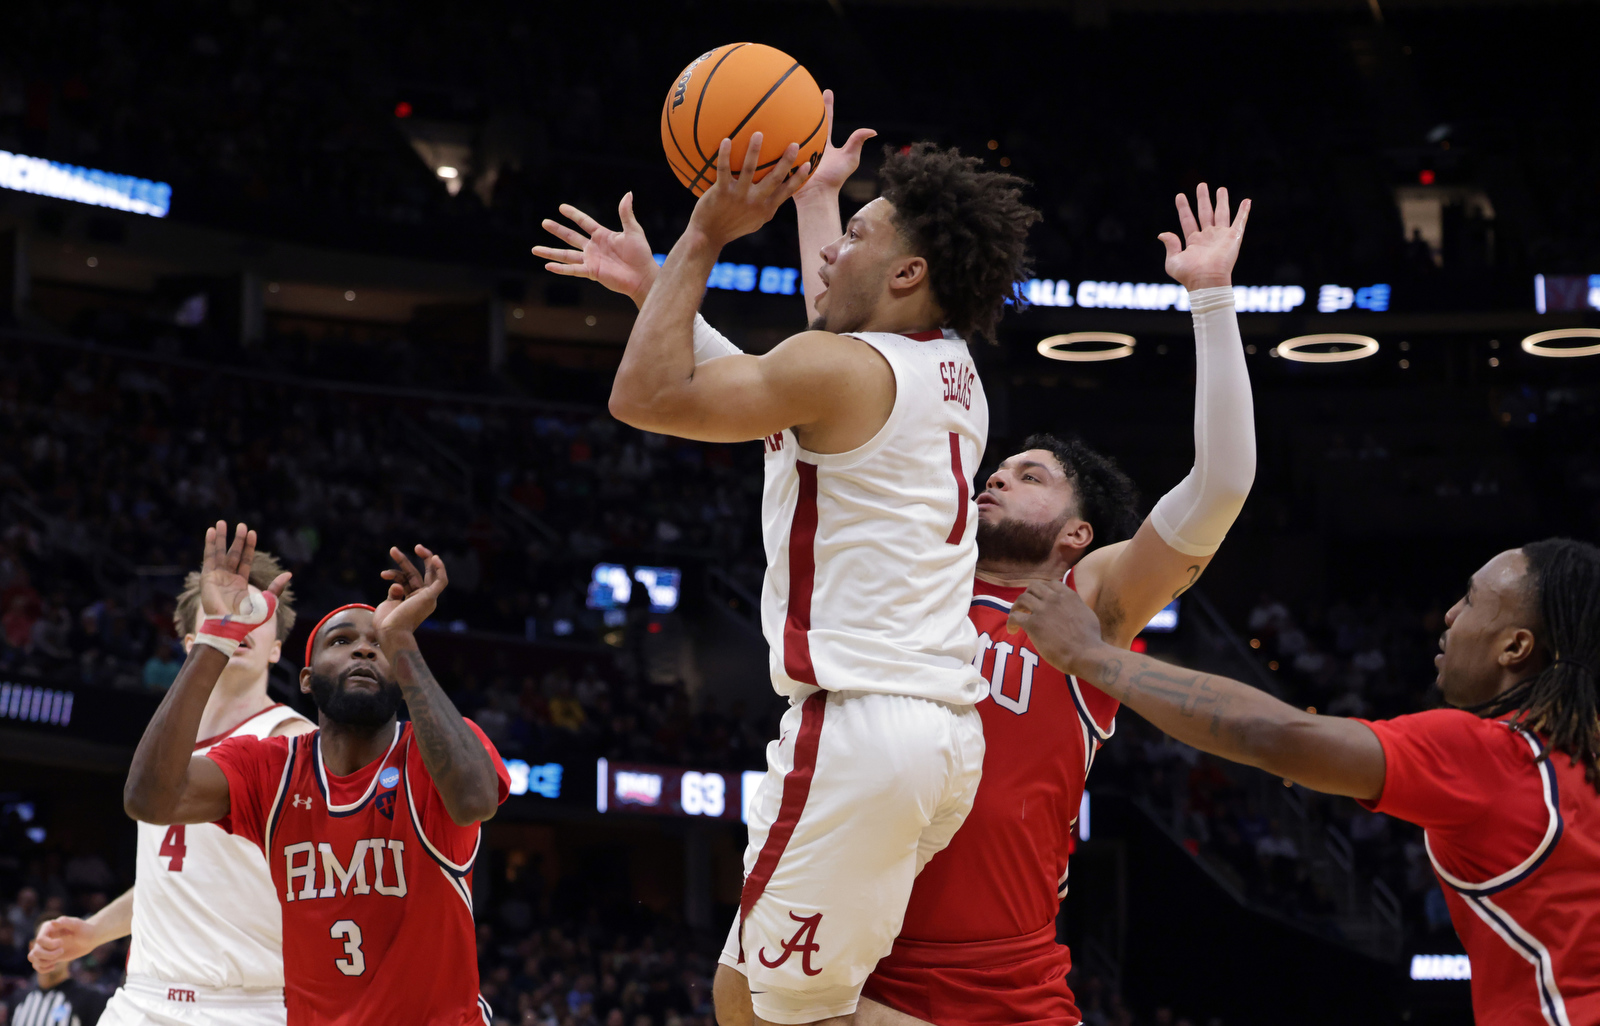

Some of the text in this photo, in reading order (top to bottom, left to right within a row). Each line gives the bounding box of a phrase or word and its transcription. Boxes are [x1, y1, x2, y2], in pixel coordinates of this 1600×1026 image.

[1076, 280, 1306, 313] CHAMPISHIP
[940, 361, 975, 411] SEARS
[945, 431, 969, 545] 1
[681, 771, 725, 817] 63
[158, 823, 187, 872] 4
[283, 838, 408, 902] RMU
[329, 919, 367, 977] 3
[758, 910, 824, 977] A
[167, 988, 197, 1003] RTR
